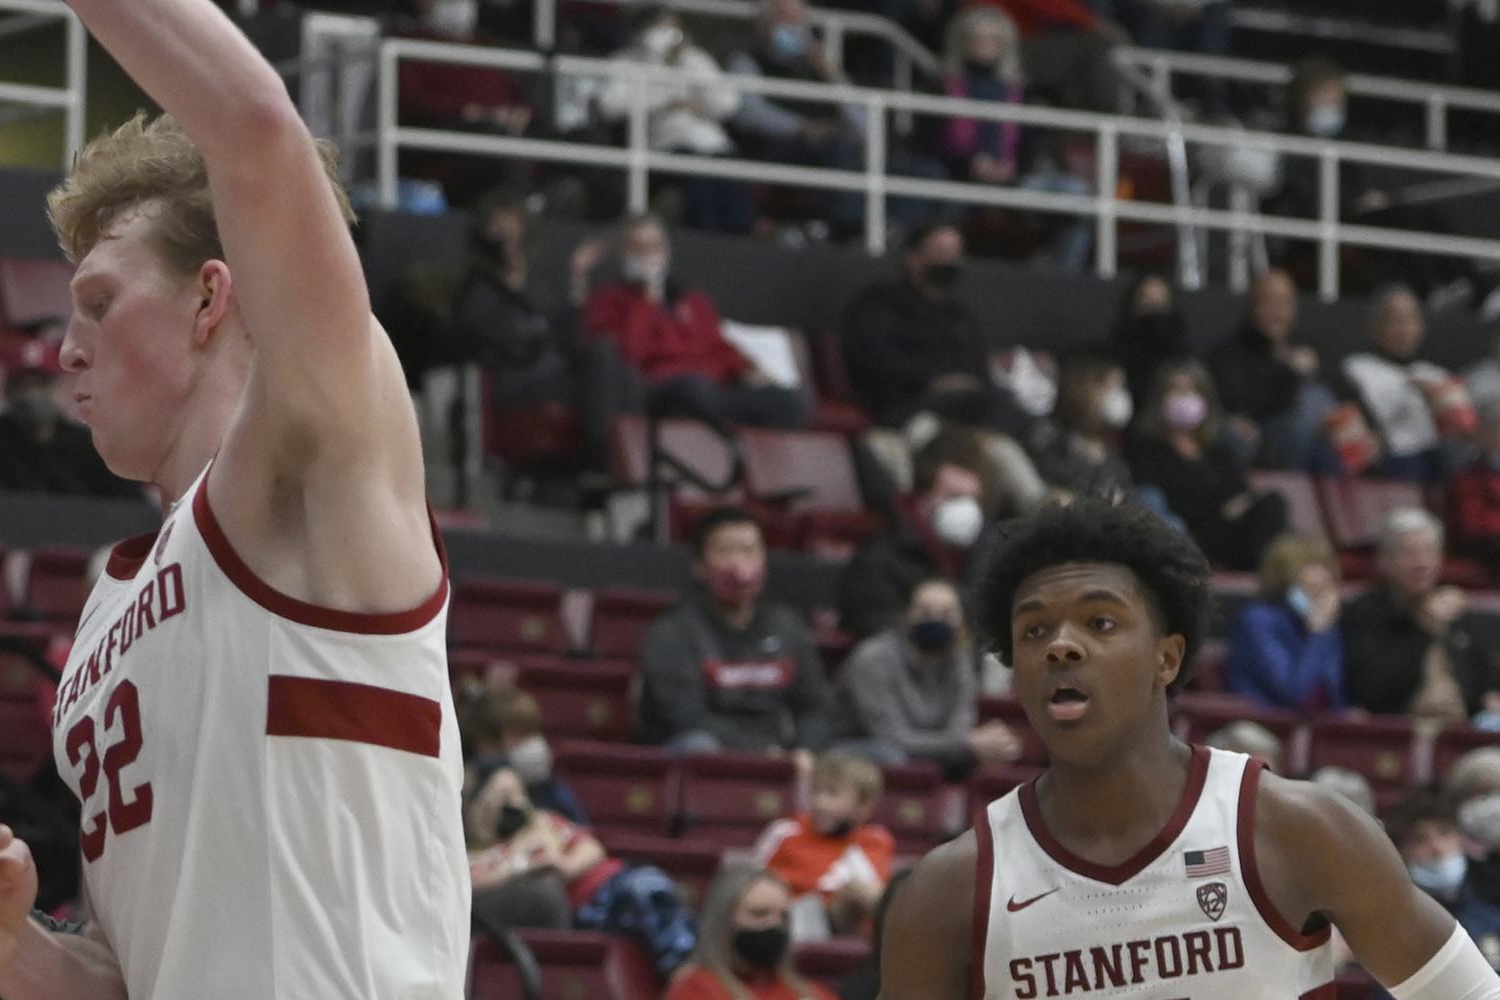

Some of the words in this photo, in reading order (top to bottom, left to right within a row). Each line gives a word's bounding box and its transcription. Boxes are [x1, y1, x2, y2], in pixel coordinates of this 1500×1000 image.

[53, 562, 186, 727] TANFORD
[65, 678, 154, 864] 22
[1008, 926, 1245, 1000] STANFORD
